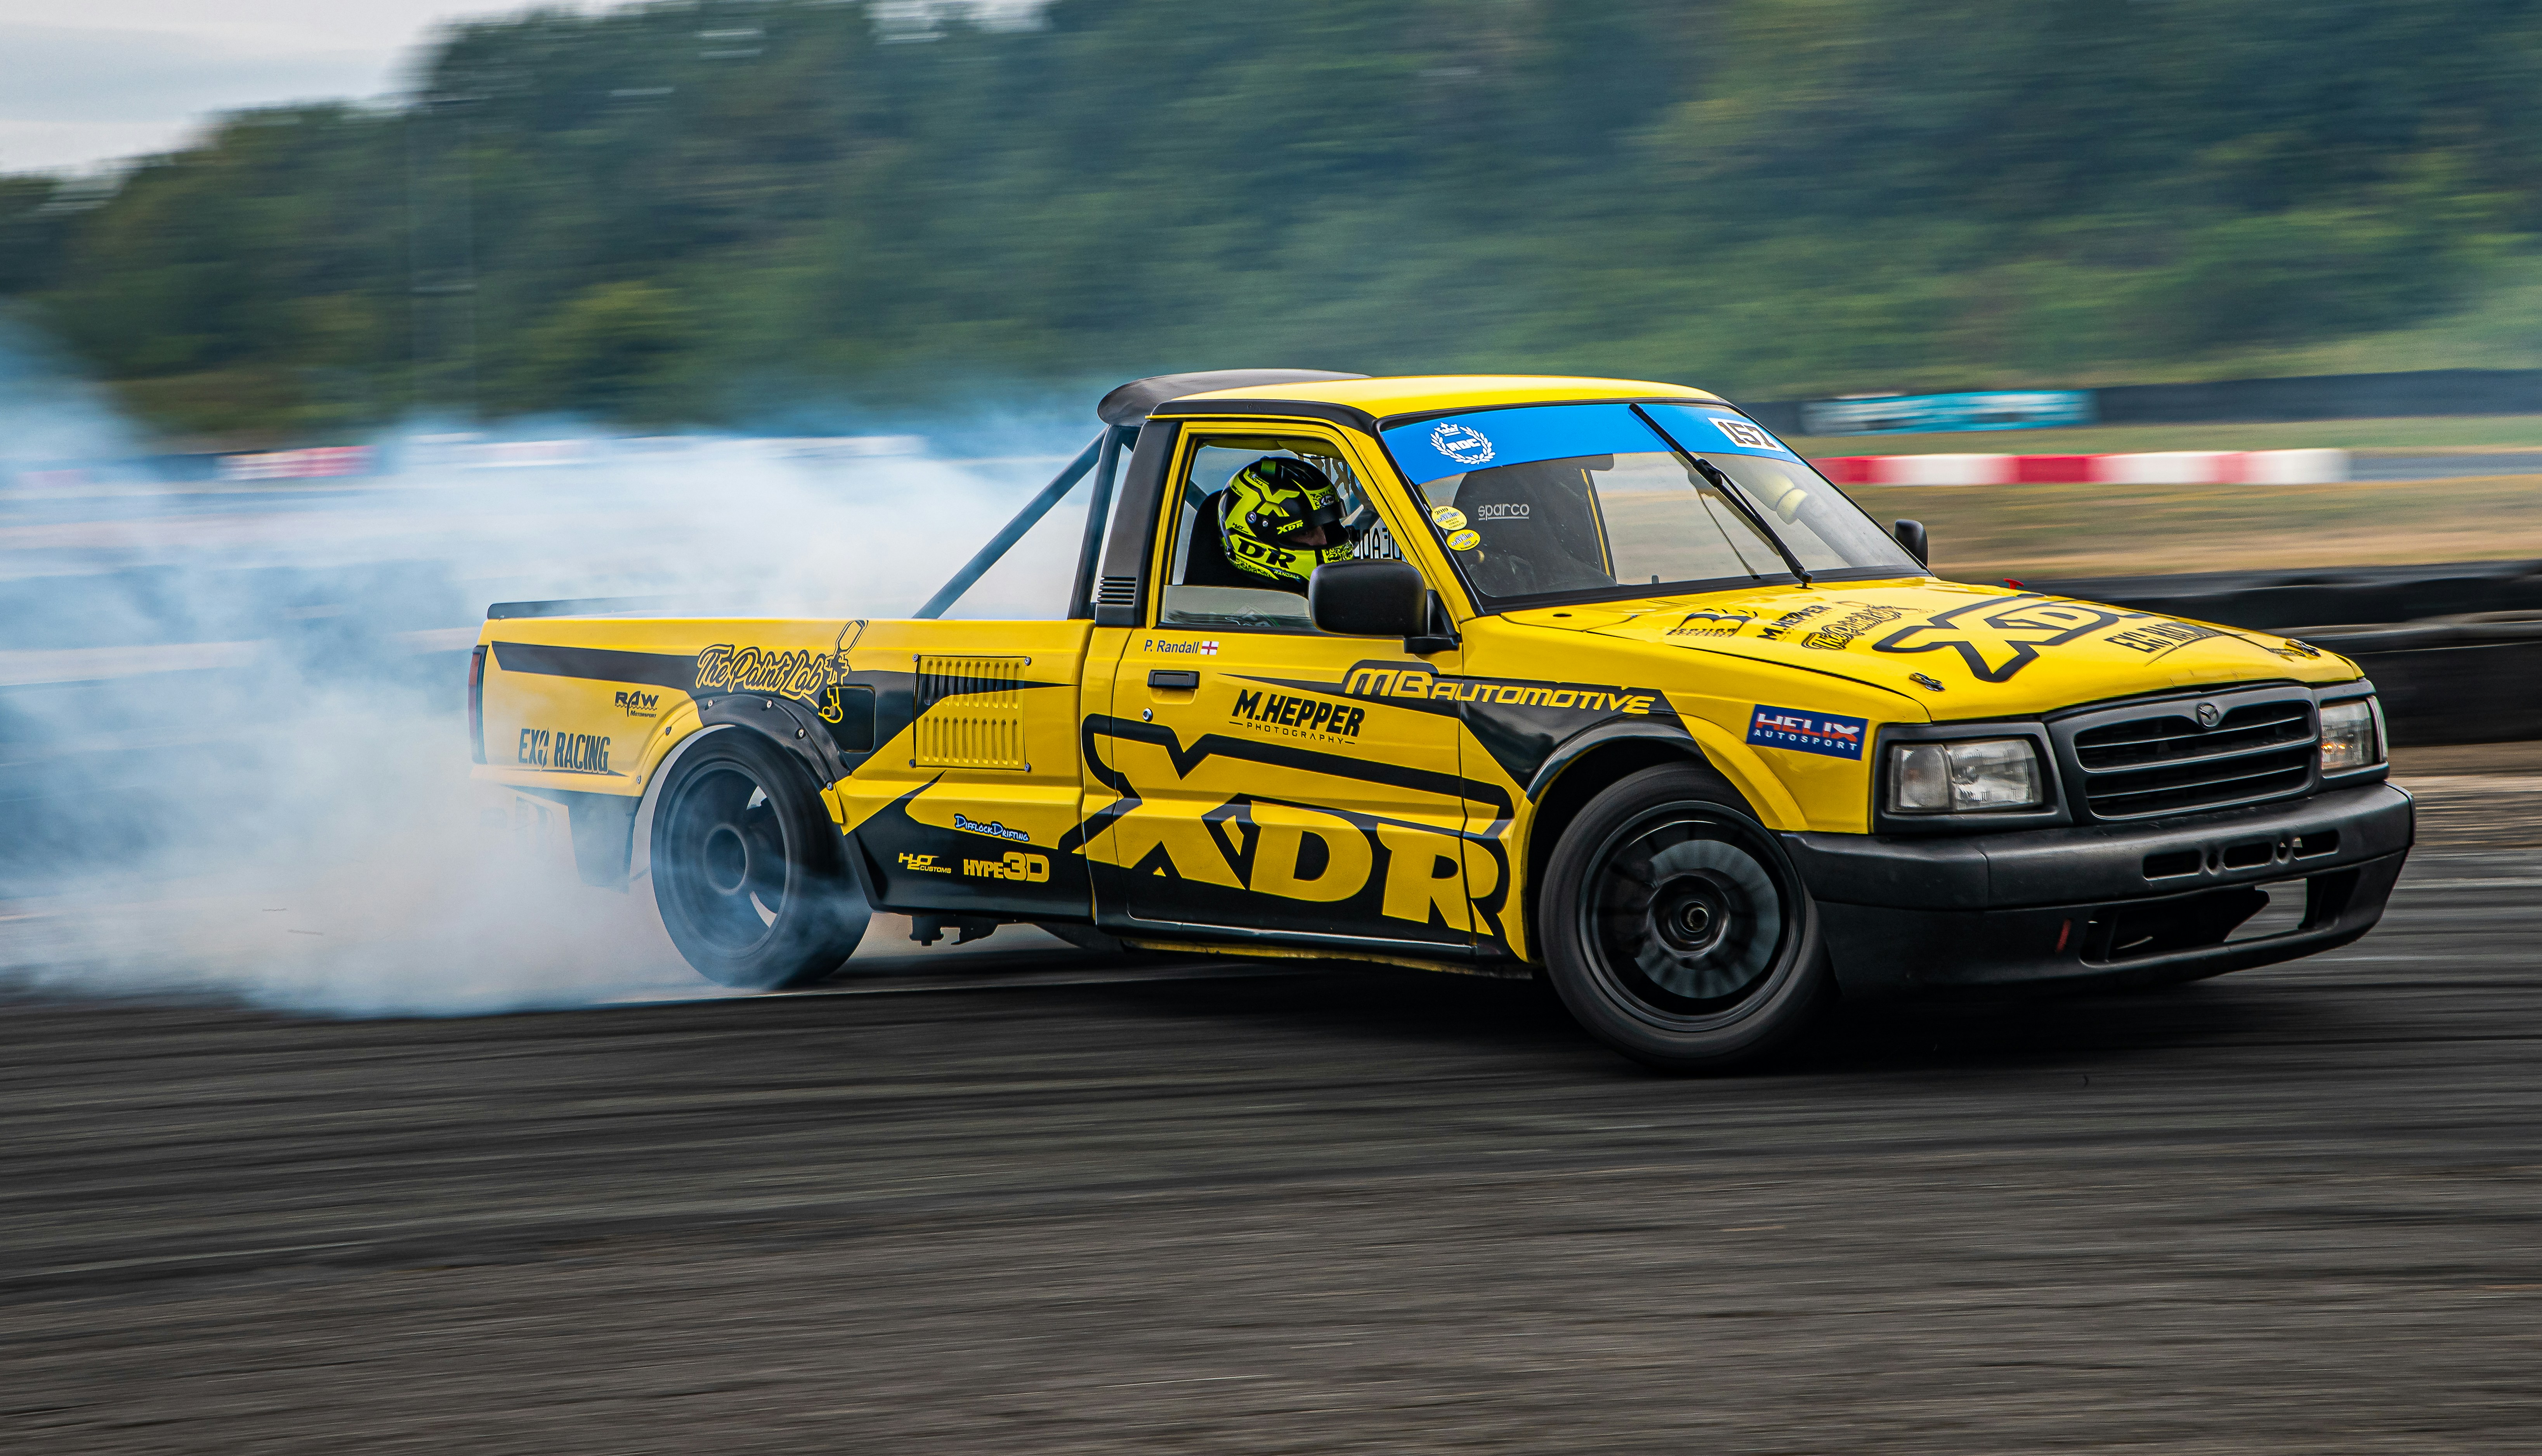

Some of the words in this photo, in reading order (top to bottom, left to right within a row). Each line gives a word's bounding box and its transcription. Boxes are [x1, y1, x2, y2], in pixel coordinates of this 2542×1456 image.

[1718, 421, 1777, 448] 157
[1478, 504, 1530, 520] sparco
[1276, 520, 1303, 535] XDR
[1274, 570, 1300, 579] RANDALL
[1144, 639, 1153, 652] P.
[1156, 640, 1200, 654] Randall
[696, 644, 735, 689] The
[727, 646, 793, 693] Paint
[779, 650, 827, 700] Lab
[614, 691, 659, 717] RAW
[1431, 682, 1656, 714] AUTOMOTIVE
[1232, 689, 1366, 737] M.HEPPER
[1247, 722, 1344, 745] PHOTOGRAPHY
[1753, 729, 1857, 751] AUTOSPORT
[1756, 712, 1860, 742] HELIX
[518, 727, 550, 769] EXO
[554, 731, 611, 772] RACING
[1074, 731, 1500, 936] XDR
[920, 865, 951, 874] CUSTOMS
